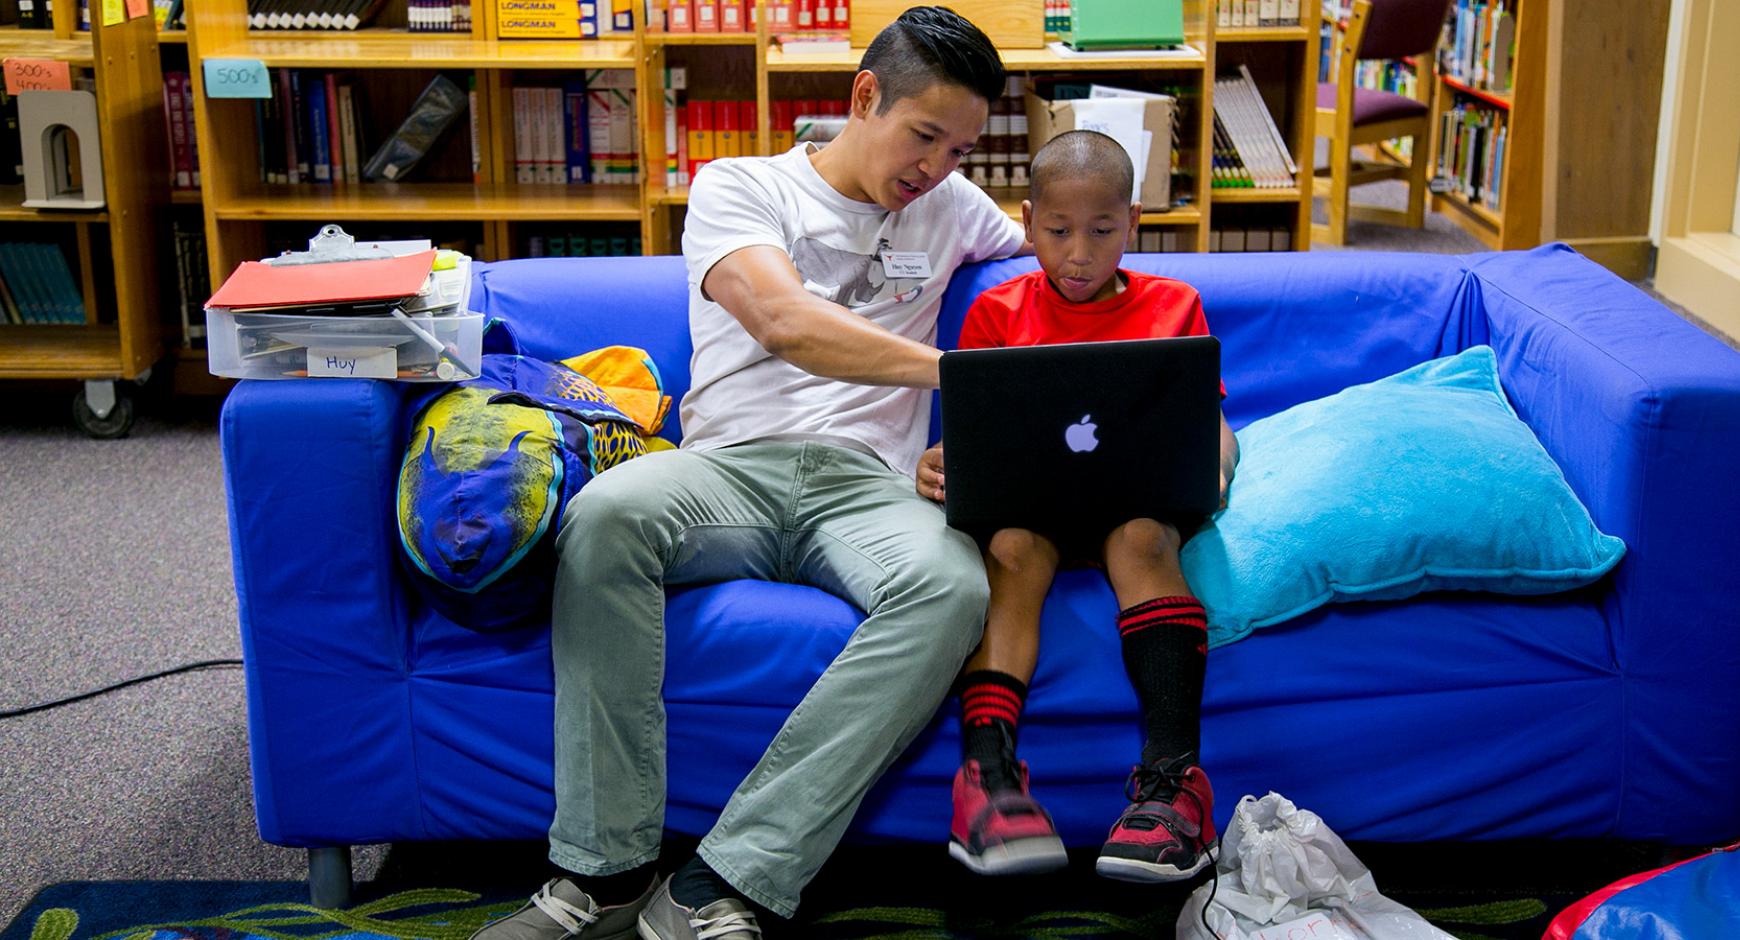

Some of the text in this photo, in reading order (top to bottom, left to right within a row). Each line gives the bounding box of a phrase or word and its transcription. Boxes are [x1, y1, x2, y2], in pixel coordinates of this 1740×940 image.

[501, 2, 556, 10] LONGMAN
[501, 20, 556, 28] LONGMAN
[15, 62, 52, 78] 300's
[216, 67, 259, 84] 500's
[326, 356, 356, 375] Huy
